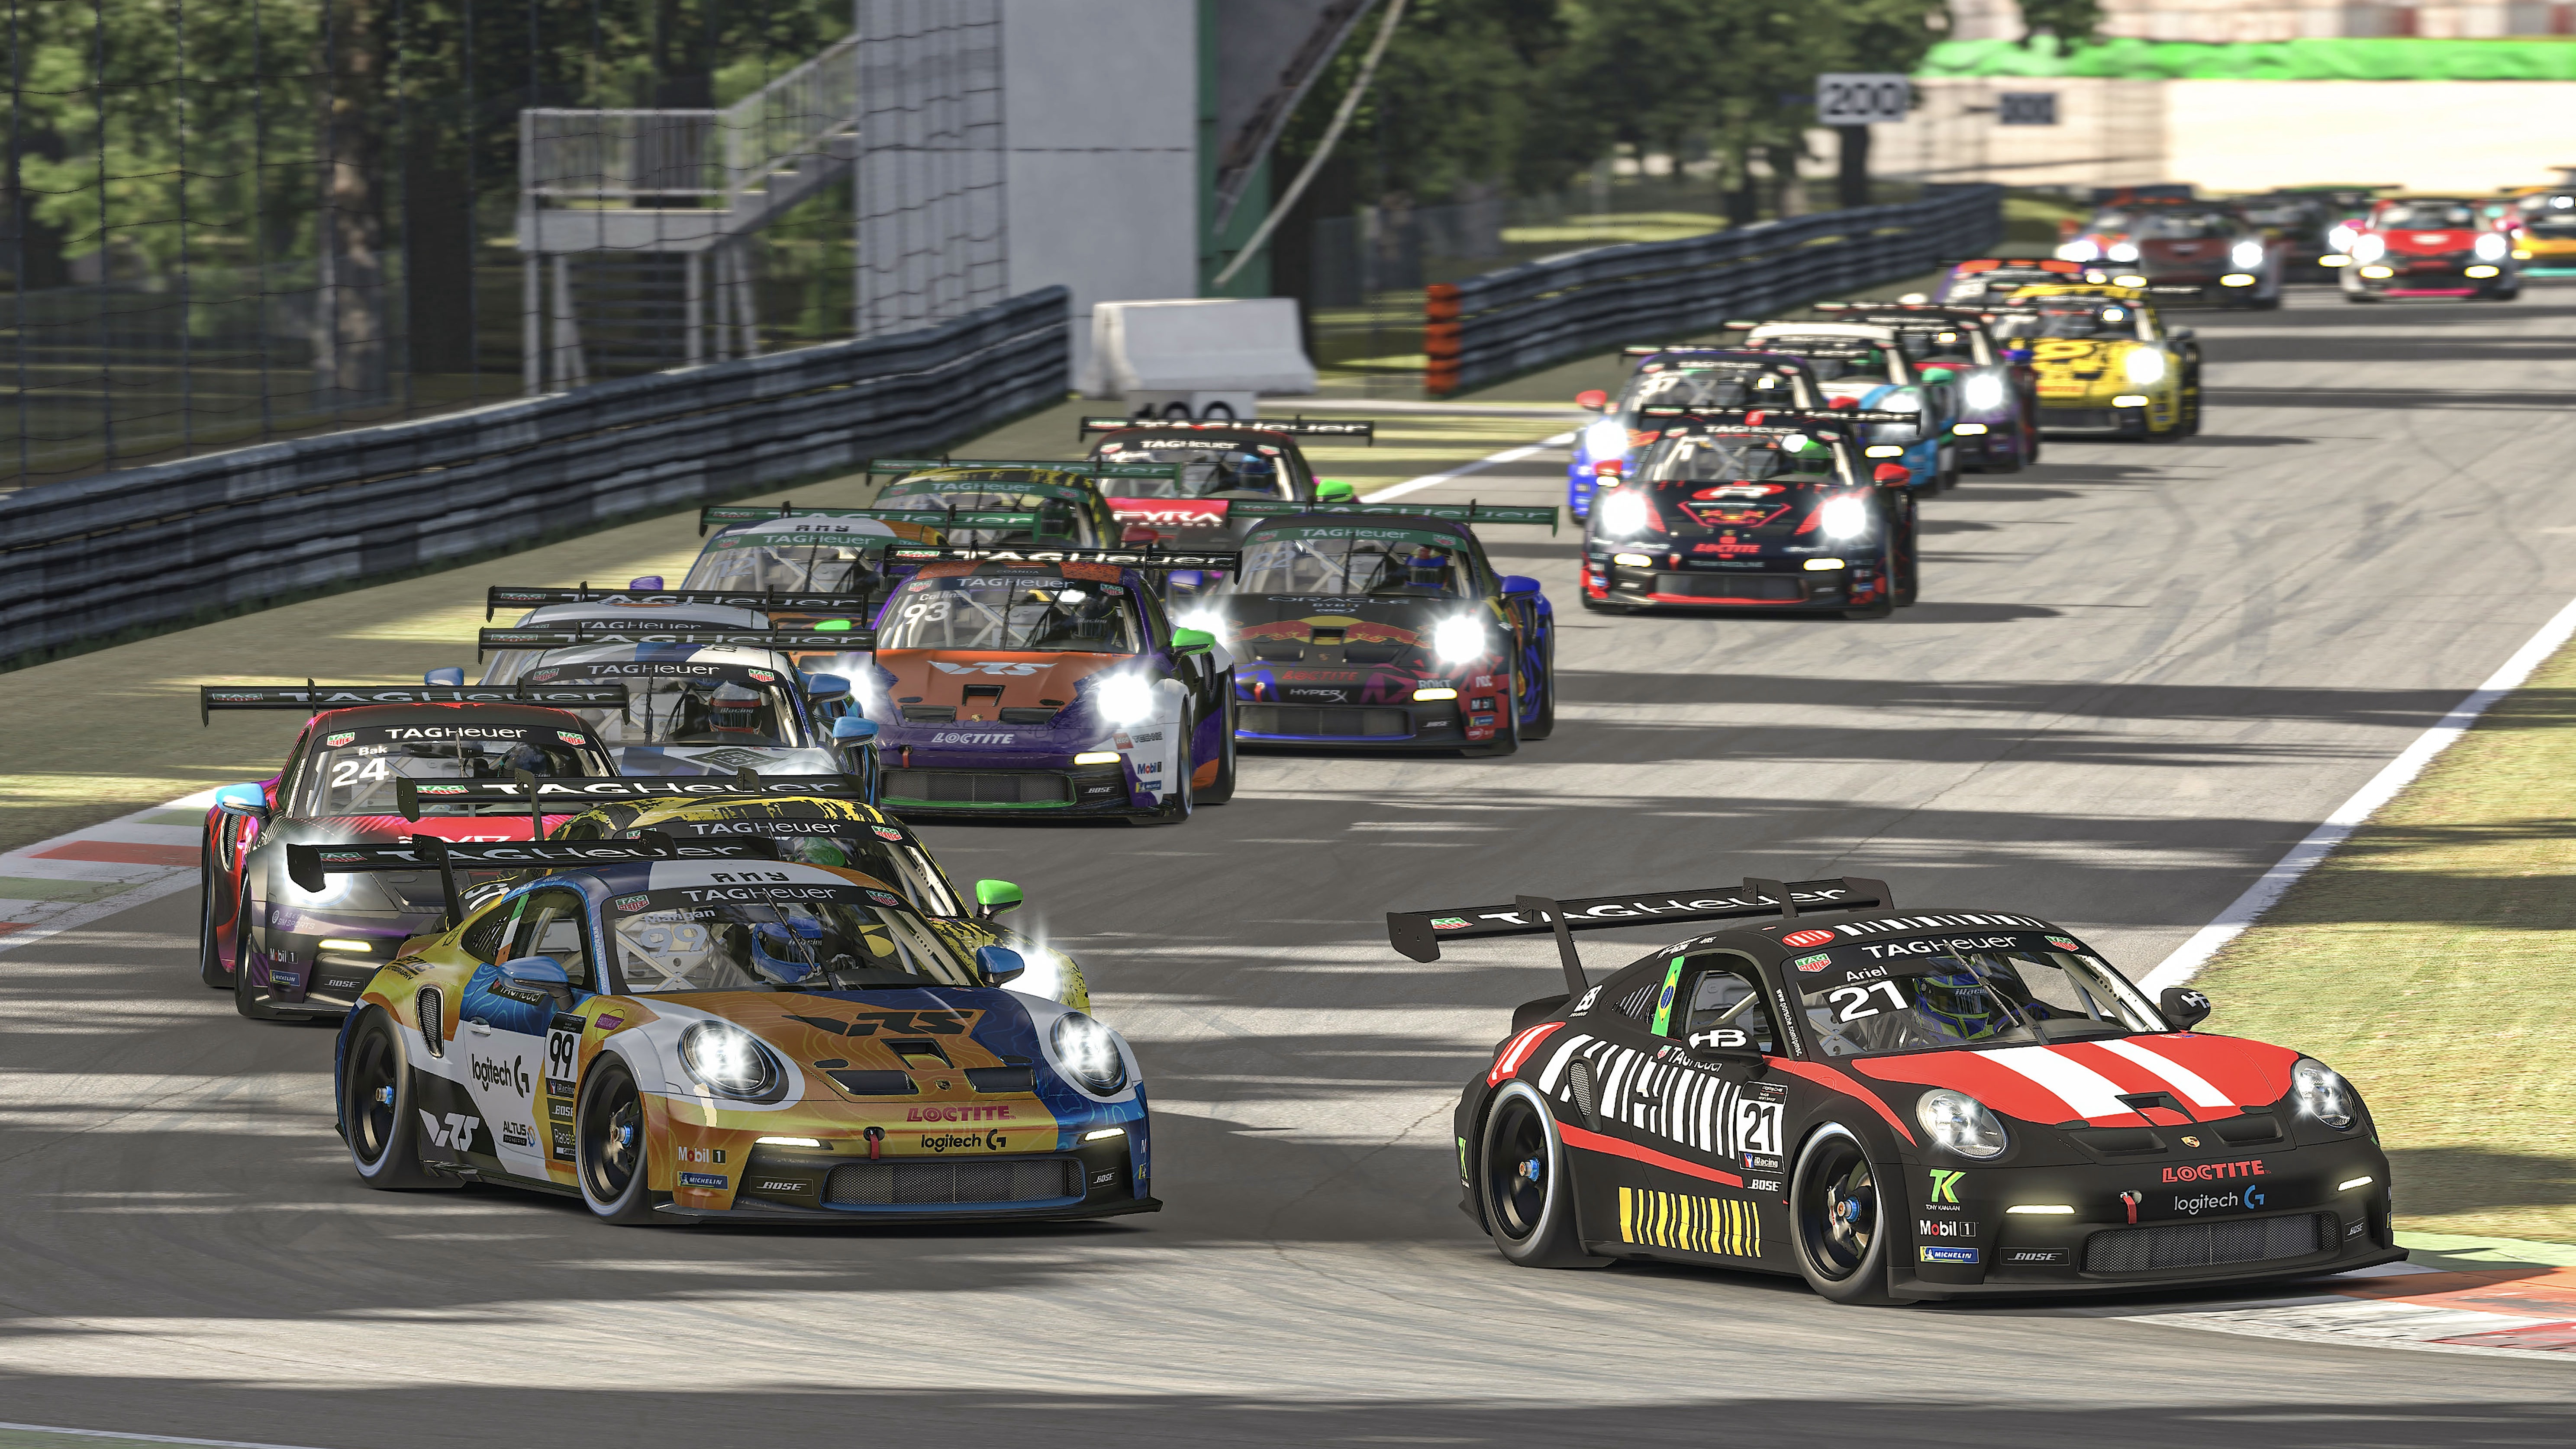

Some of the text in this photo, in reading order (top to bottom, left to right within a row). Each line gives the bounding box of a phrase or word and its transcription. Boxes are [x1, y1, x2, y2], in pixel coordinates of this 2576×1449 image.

[1826, 82, 1897, 116] 200
[1140, 440, 1240, 449] TAGHeuer
[931, 483, 1036, 491] TAGHeuer
[1113, 510, 1223, 522] FYRA
[763, 535, 876, 545] TAGHeuer
[1300, 529, 1411, 539] TAGHeuer
[953, 551, 1235, 564] TAGHeuer
[1250, 550, 1296, 572] 22
[957, 578, 1075, 588] TAGHeuer
[1267, 596, 1410, 604] ORACLE
[904, 601, 951, 625] 93
[554, 634, 867, 643] TAGHeuer
[587, 665, 720, 675] TAGHeuer
[1281, 671, 1359, 681] LOCTITE
[279, 692, 614, 702] TAGHeuer
[385, 727, 528, 739] TAGHeuer
[931, 733, 1015, 744] LOCTITE
[358, 745, 388, 755] Bak
[332, 758, 389, 788] 24
[1138, 763, 1156, 774] Mobil
[482, 782, 840, 794] TAGHeuer
[689, 822, 841, 835] TAGHeuer
[376, 846, 743, 861] TAGHeuer
[621, 895, 646, 904] TAG
[681, 887, 836, 903] TAGHeuer
[619, 901, 648, 911] HEUER
[1478, 889, 1846, 925] TAGHeuer
[1431, 917, 1466, 926] AG
[641, 923, 707, 958] 99
[1861, 935, 2017, 958] TAGHeuer
[270, 948, 287, 962] Mobil
[1797, 954, 1828, 966] TAG
[1799, 960, 1831, 971] HEUER
[1846, 965, 1887, 982] Ariel
[324, 979, 360, 988] BOSE
[1828, 980, 1909, 1023] 21
[549, 1032, 574, 1078] 99
[471, 1054, 529, 1098] logitech G
[907, 1105, 1010, 1122] LOCTITE
[503, 1120, 526, 1136] ALTUS
[1744, 1103, 1775, 1152] 21
[921, 1129, 1007, 1153] logitech G
[678, 1146, 709, 1163] Mobil
[1754, 1156, 1778, 1168] iRacing
[2162, 1159, 2266, 1183] LOCTITE
[689, 1177, 722, 1185] MICHELIN
[1093, 1173, 1113, 1184] BOSE
[757, 1181, 806, 1191] BOSE
[1747, 1178, 1782, 1192] BOSE
[1929, 1169, 1967, 1204] TK
[2173, 1184, 2265, 1215] logitech G
[1919, 1219, 1957, 1236] Mobil
[2347, 1222, 2364, 1236] BOSE
[1934, 1251, 1972, 1259] MICHELIN
[2007, 1252, 2063, 1261] BOSE
